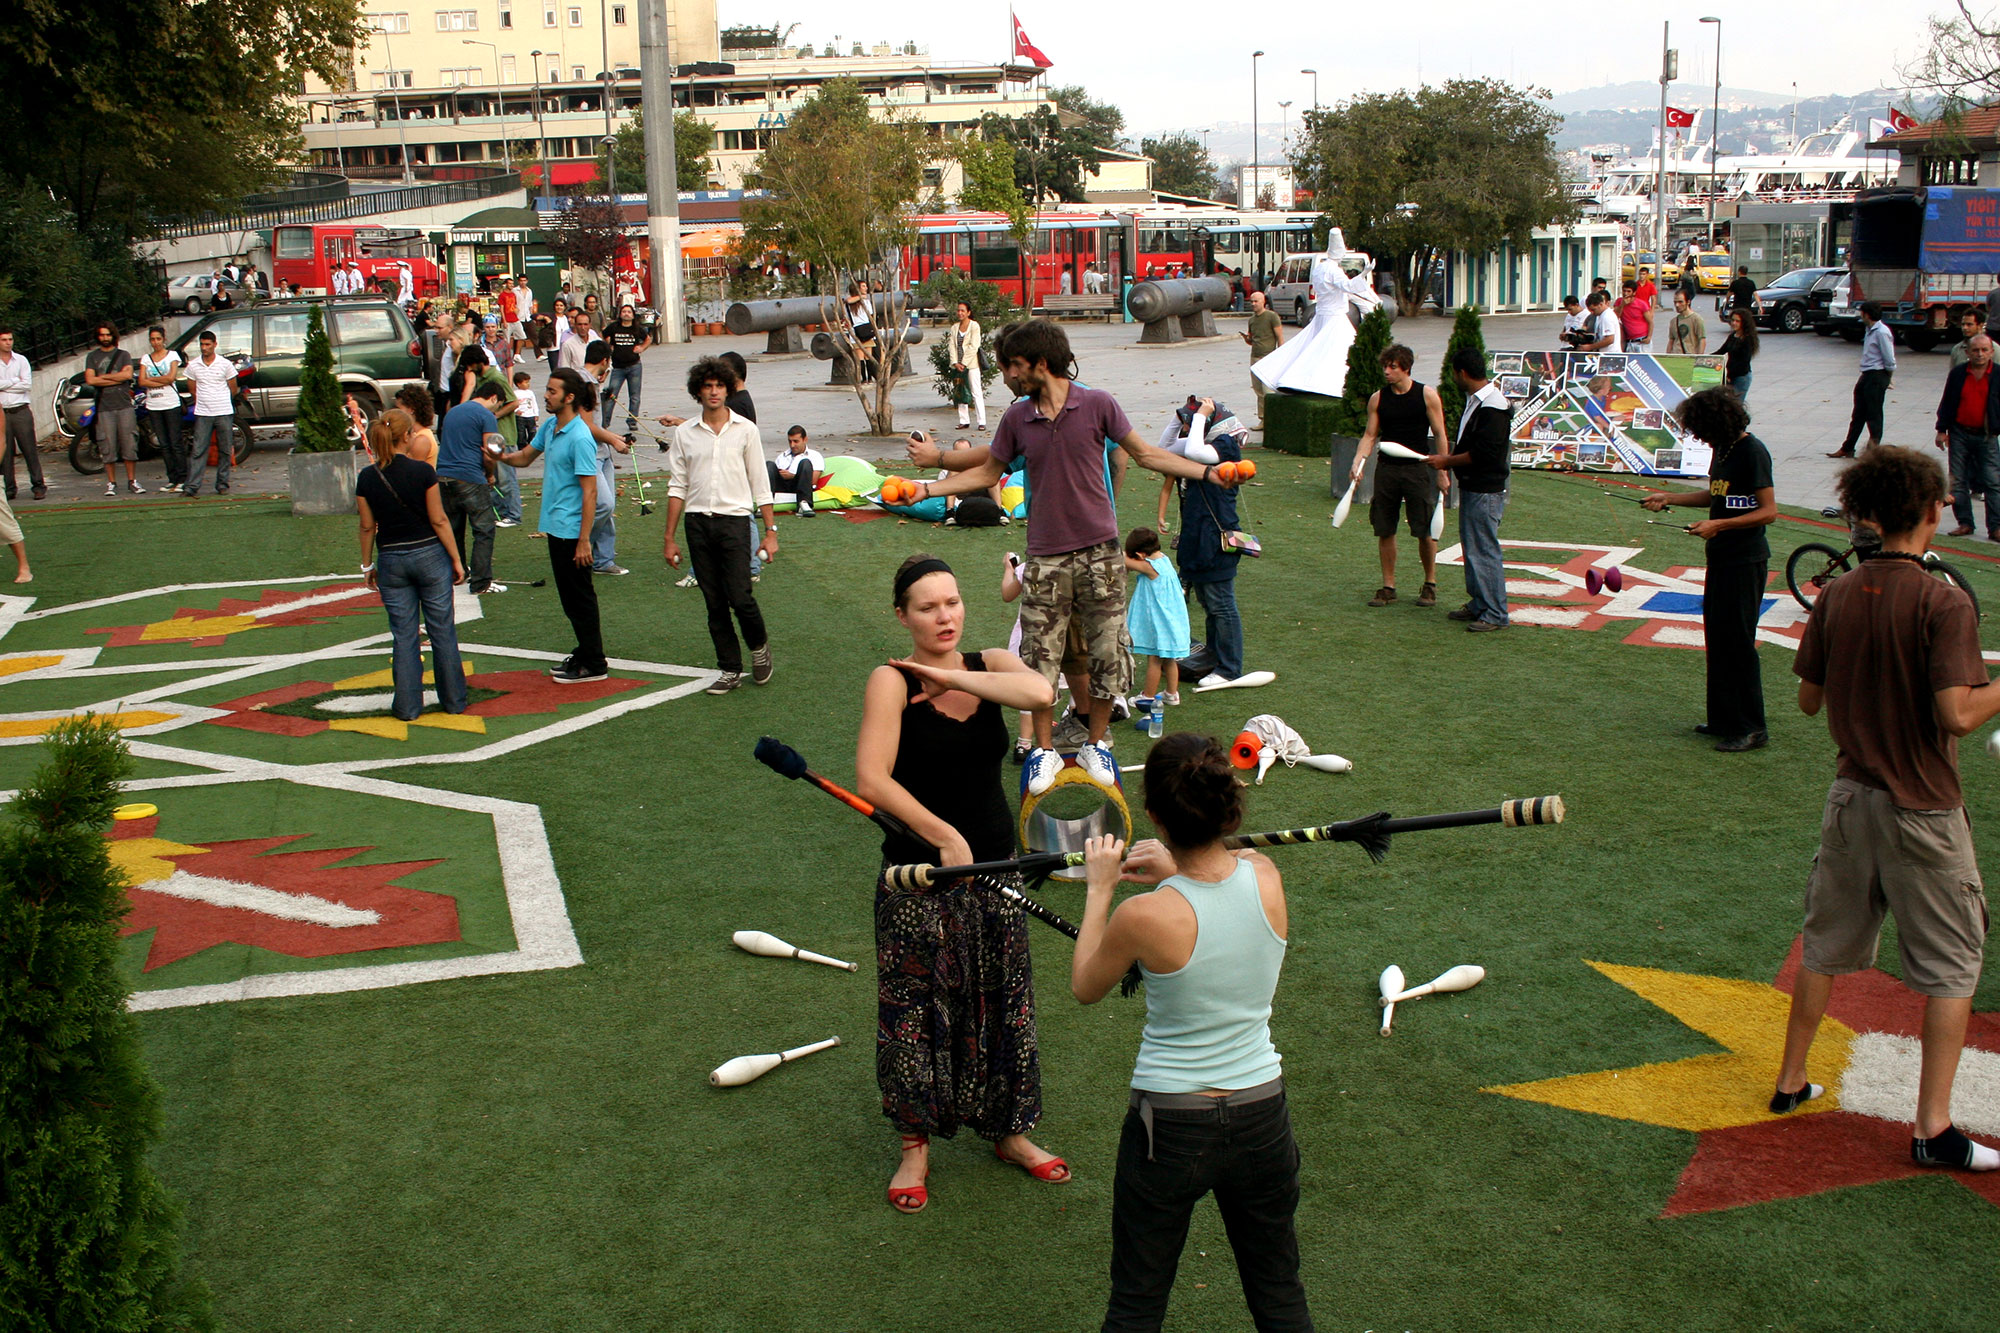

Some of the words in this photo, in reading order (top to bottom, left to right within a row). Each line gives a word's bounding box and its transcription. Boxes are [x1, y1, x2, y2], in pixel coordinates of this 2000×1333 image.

[453, 232, 484, 242] UMUT
[494, 230, 520, 242] BÜFE
[1628, 359, 1665, 400] Amsterdam
[1511, 398, 1545, 432] otterdam
[1533, 430, 1559, 440] Berlin
[1613, 436, 1645, 472] Budapest
[1726, 494, 1758, 509] me
